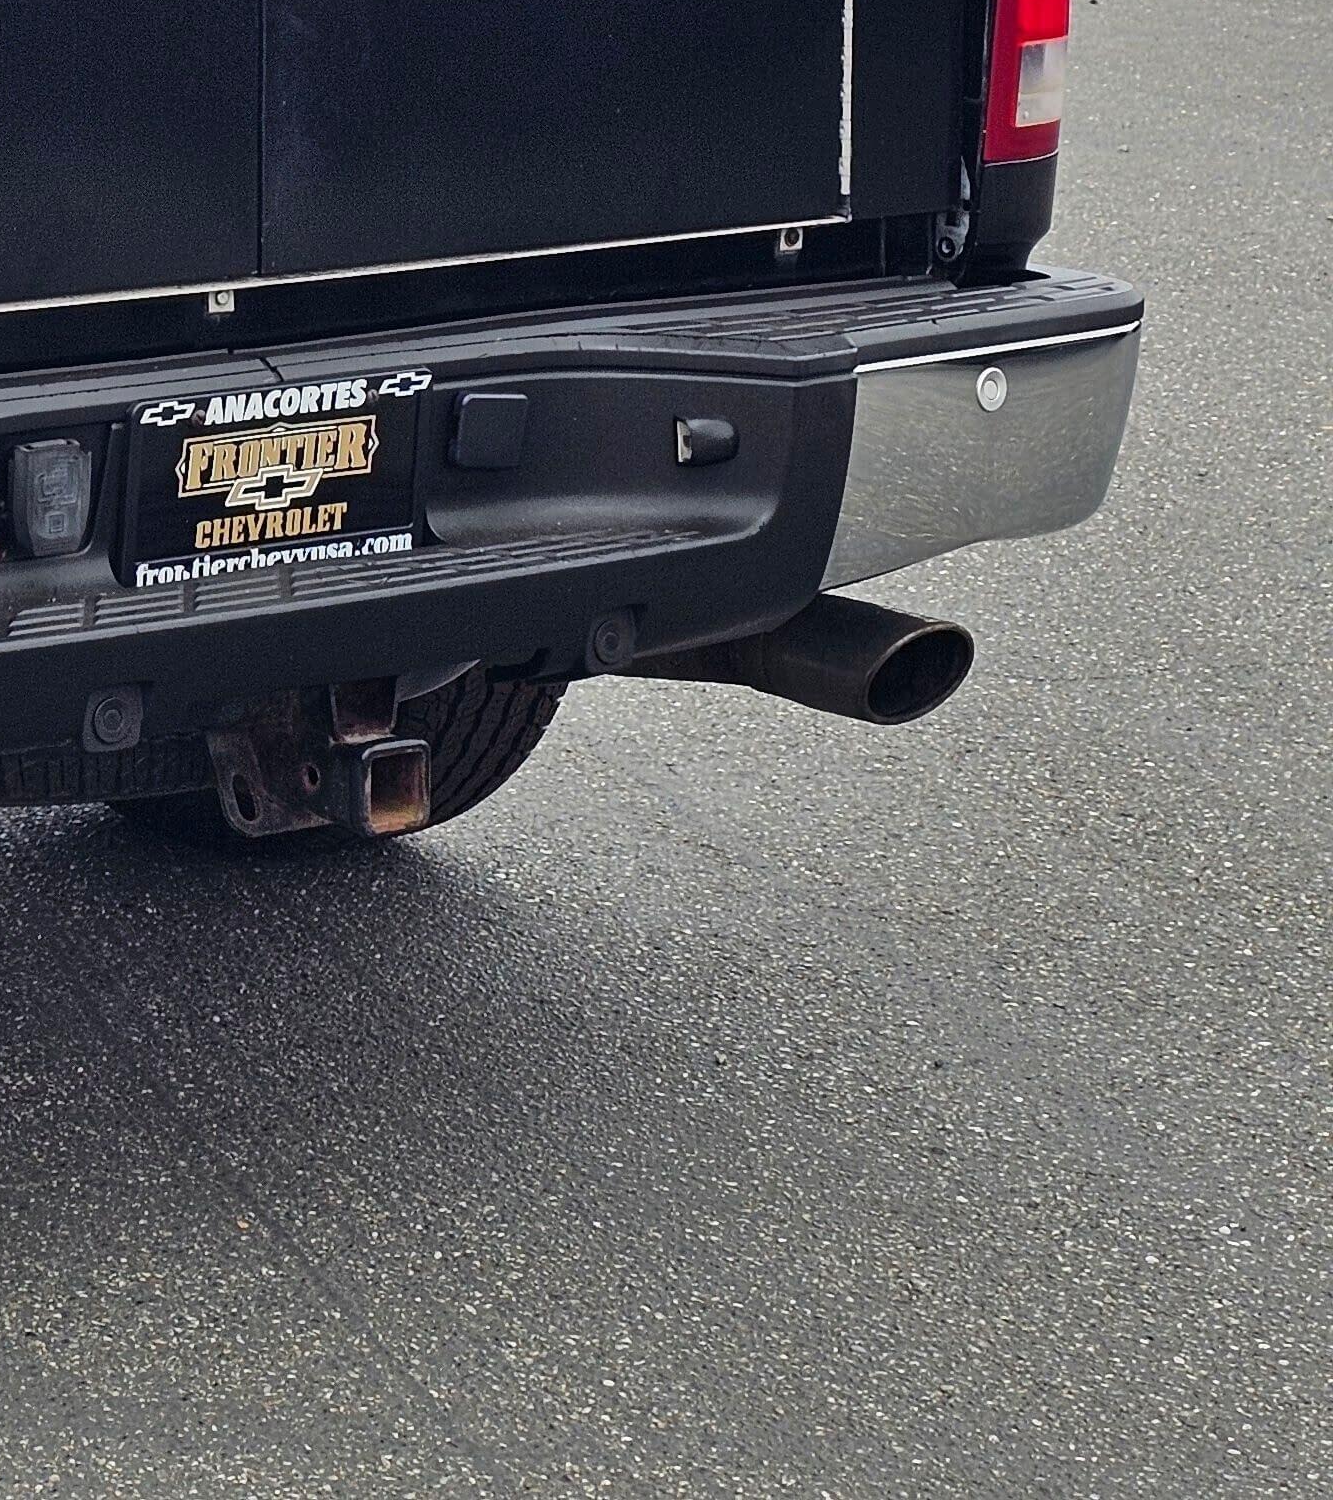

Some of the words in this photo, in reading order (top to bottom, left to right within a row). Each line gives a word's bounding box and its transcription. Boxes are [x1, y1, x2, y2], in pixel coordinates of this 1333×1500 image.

[203, 379, 367, 426] ANACORTES
[185, 423, 367, 491] FRONTIER
[194, 502, 348, 548] CHEVROLET
